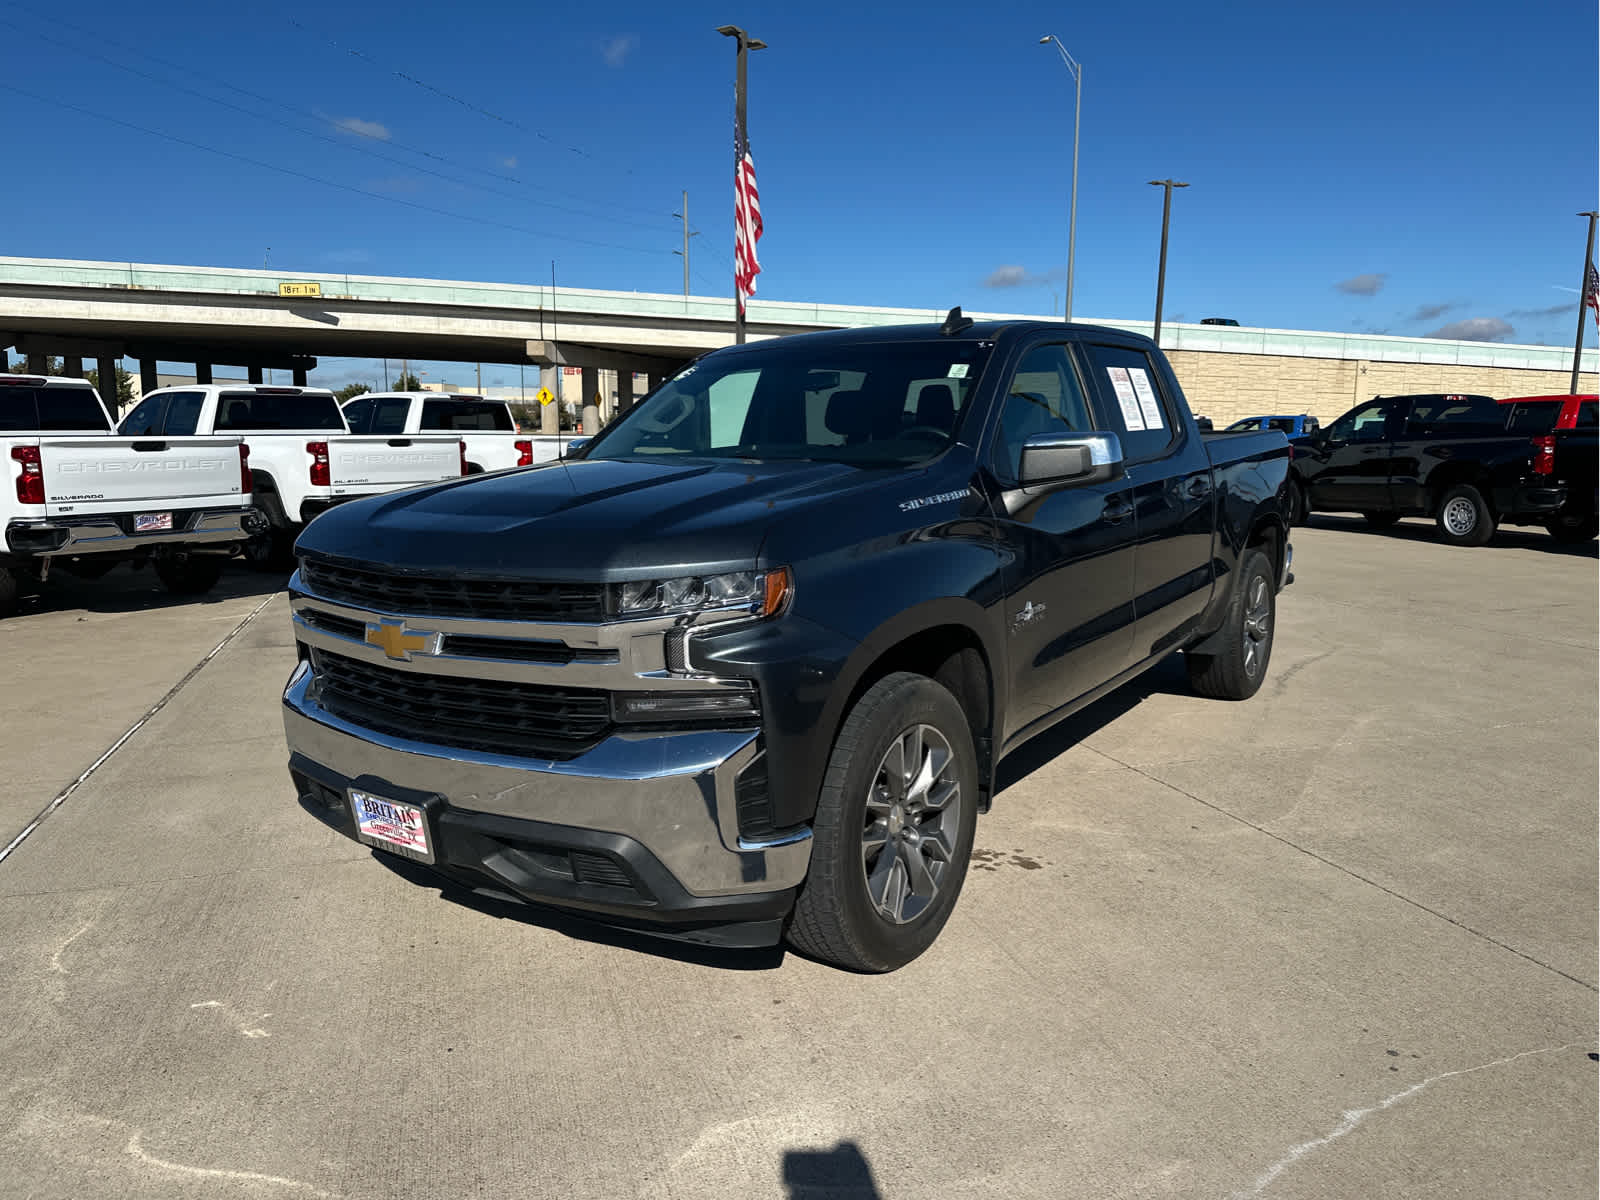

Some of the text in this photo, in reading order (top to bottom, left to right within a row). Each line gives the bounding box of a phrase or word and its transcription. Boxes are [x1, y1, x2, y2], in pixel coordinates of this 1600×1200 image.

[284, 286, 291, 294] 18
[58, 458, 232, 472] CHEVROLET
[899, 488, 971, 512] SILVERADO
[363, 799, 417, 827] BRITAIN
[407, 830, 417, 843] TX
